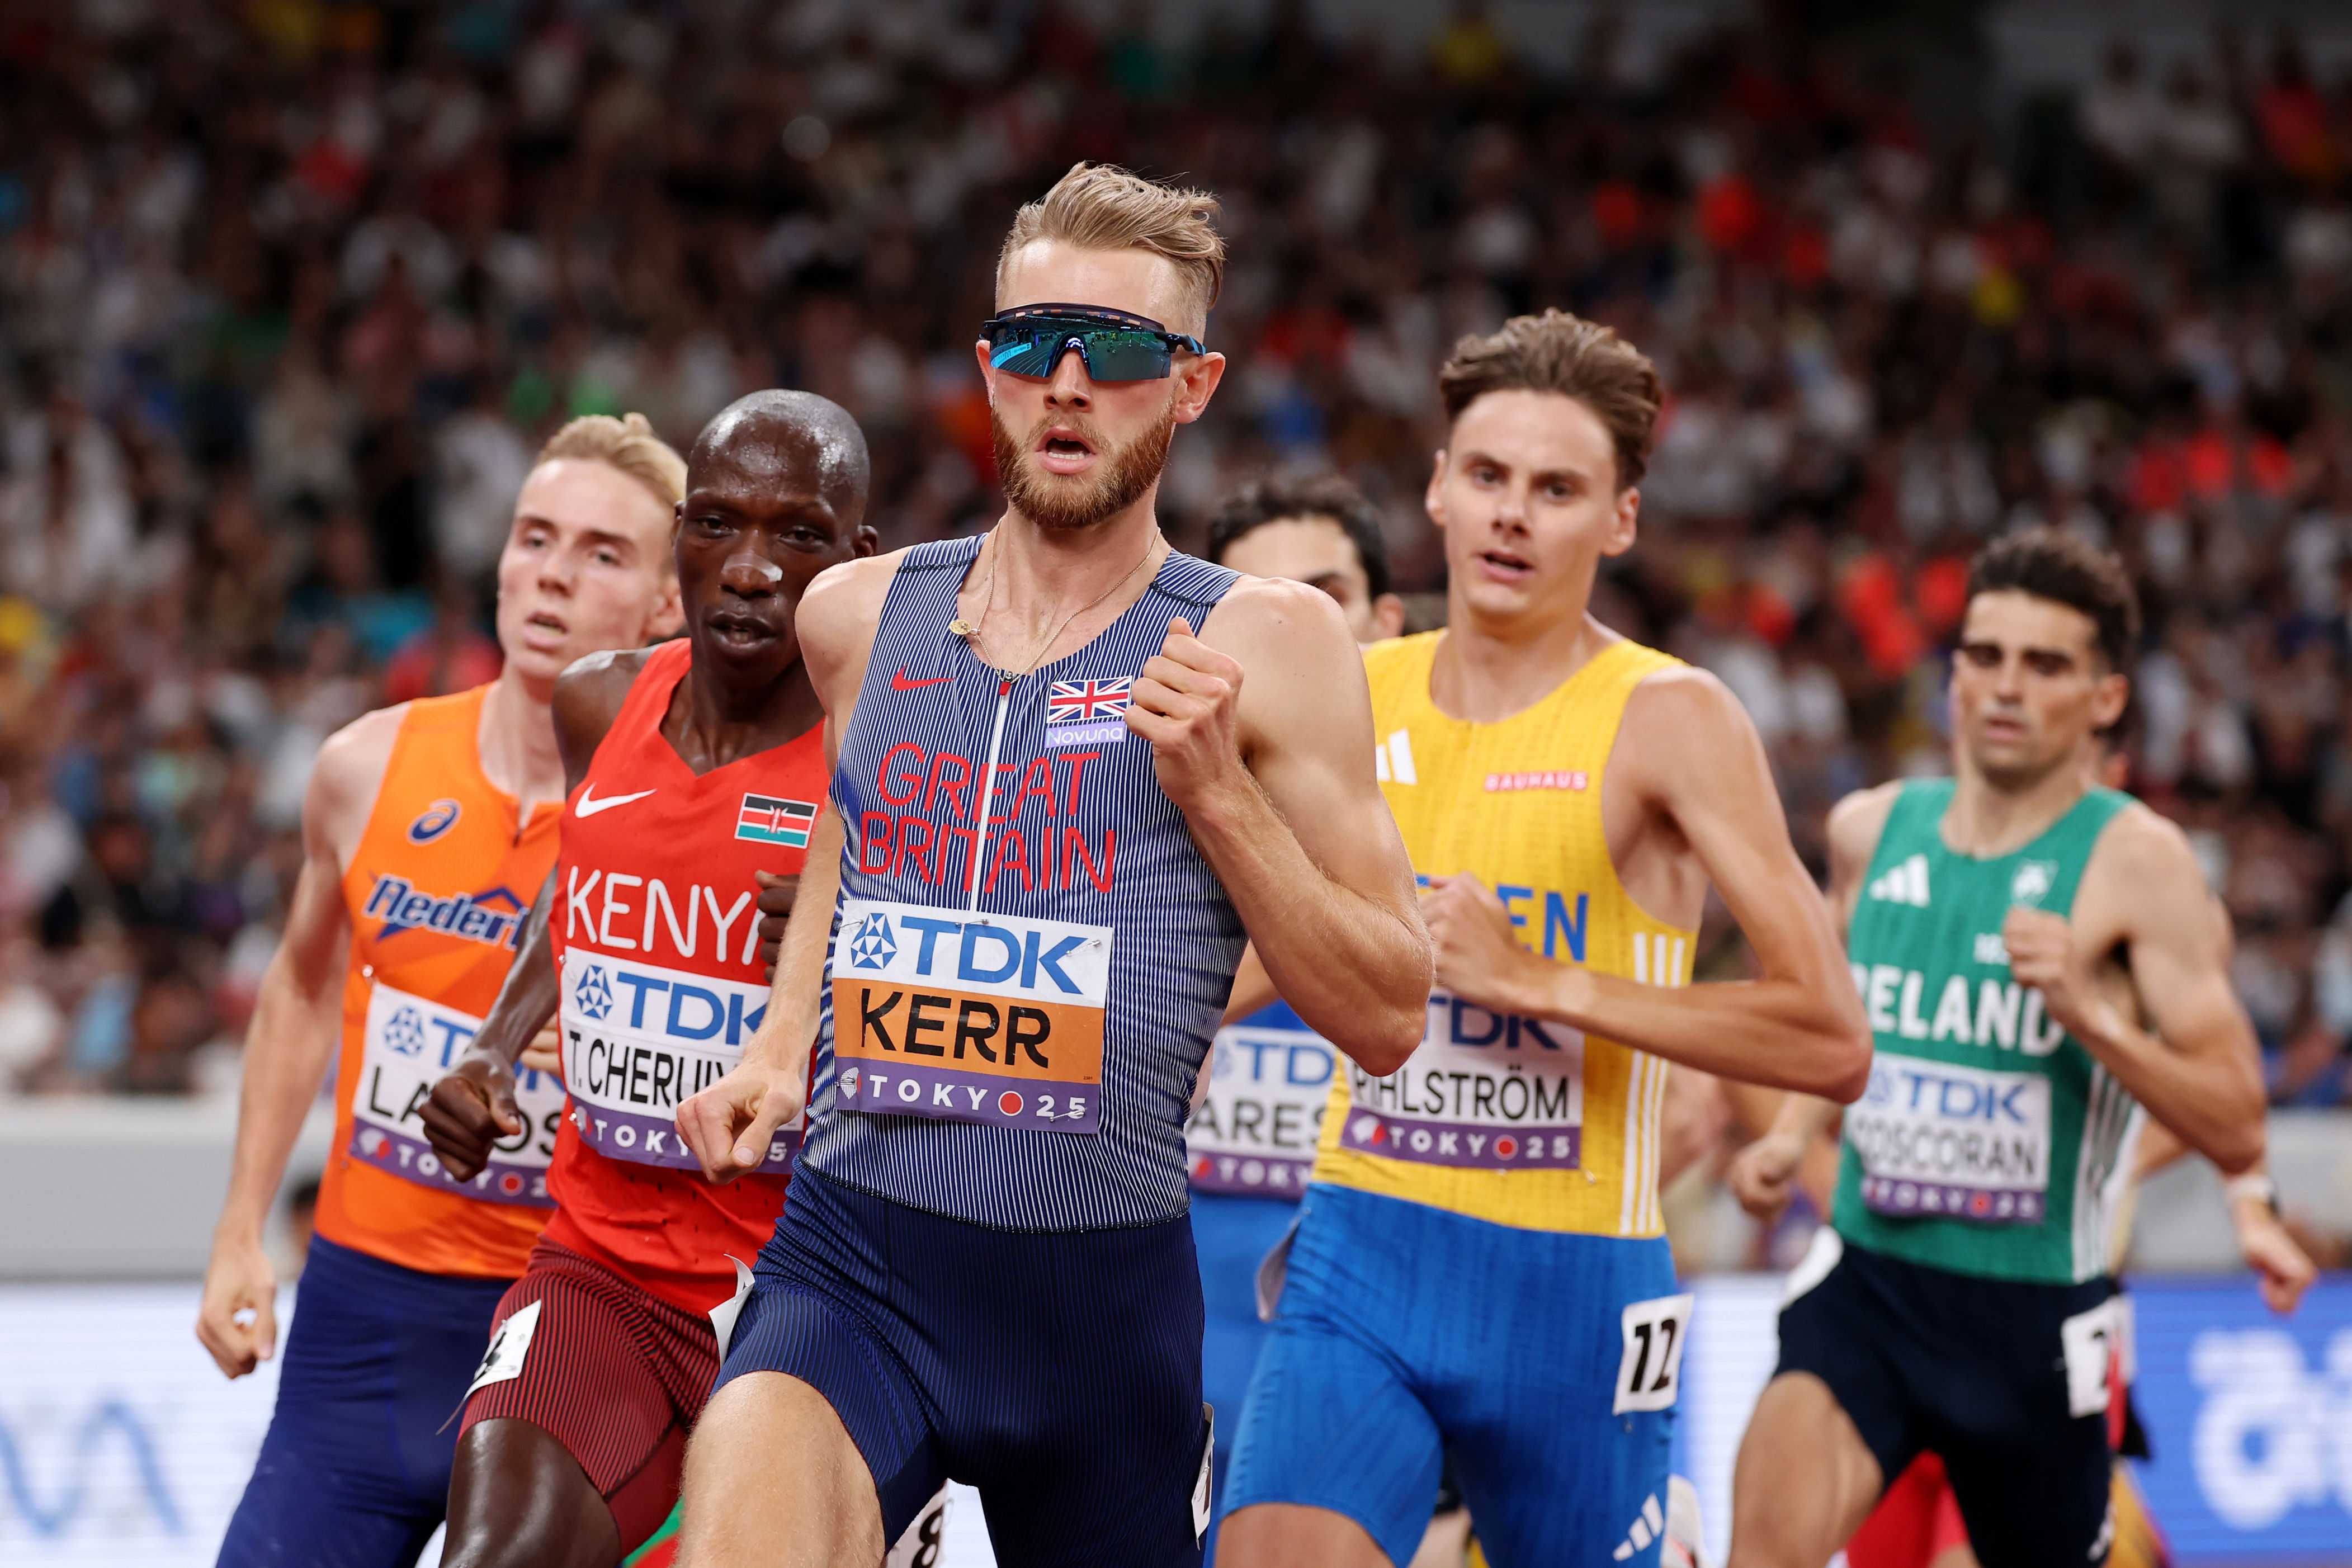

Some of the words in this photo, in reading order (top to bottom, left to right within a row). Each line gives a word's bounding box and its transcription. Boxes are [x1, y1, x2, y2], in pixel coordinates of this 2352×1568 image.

[1046, 726, 1123, 746] Novuna
[877, 742, 1101, 824] GREAT
[1484, 771, 1588, 791] BAUHAUS
[859, 810, 1115, 894] BRITAIN
[566, 865, 767, 966] KENY
[900, 915, 1089, 995] TDK
[861, 988, 1051, 1069] KERR
[1850, 962, 2066, 1056] ELAND
[588, 1038, 738, 1108] CHERUI
[1236, 1039, 1336, 1086] TD
[1902, 1069, 2028, 1123] TDK
[1630, 1318, 1676, 1392] 12
